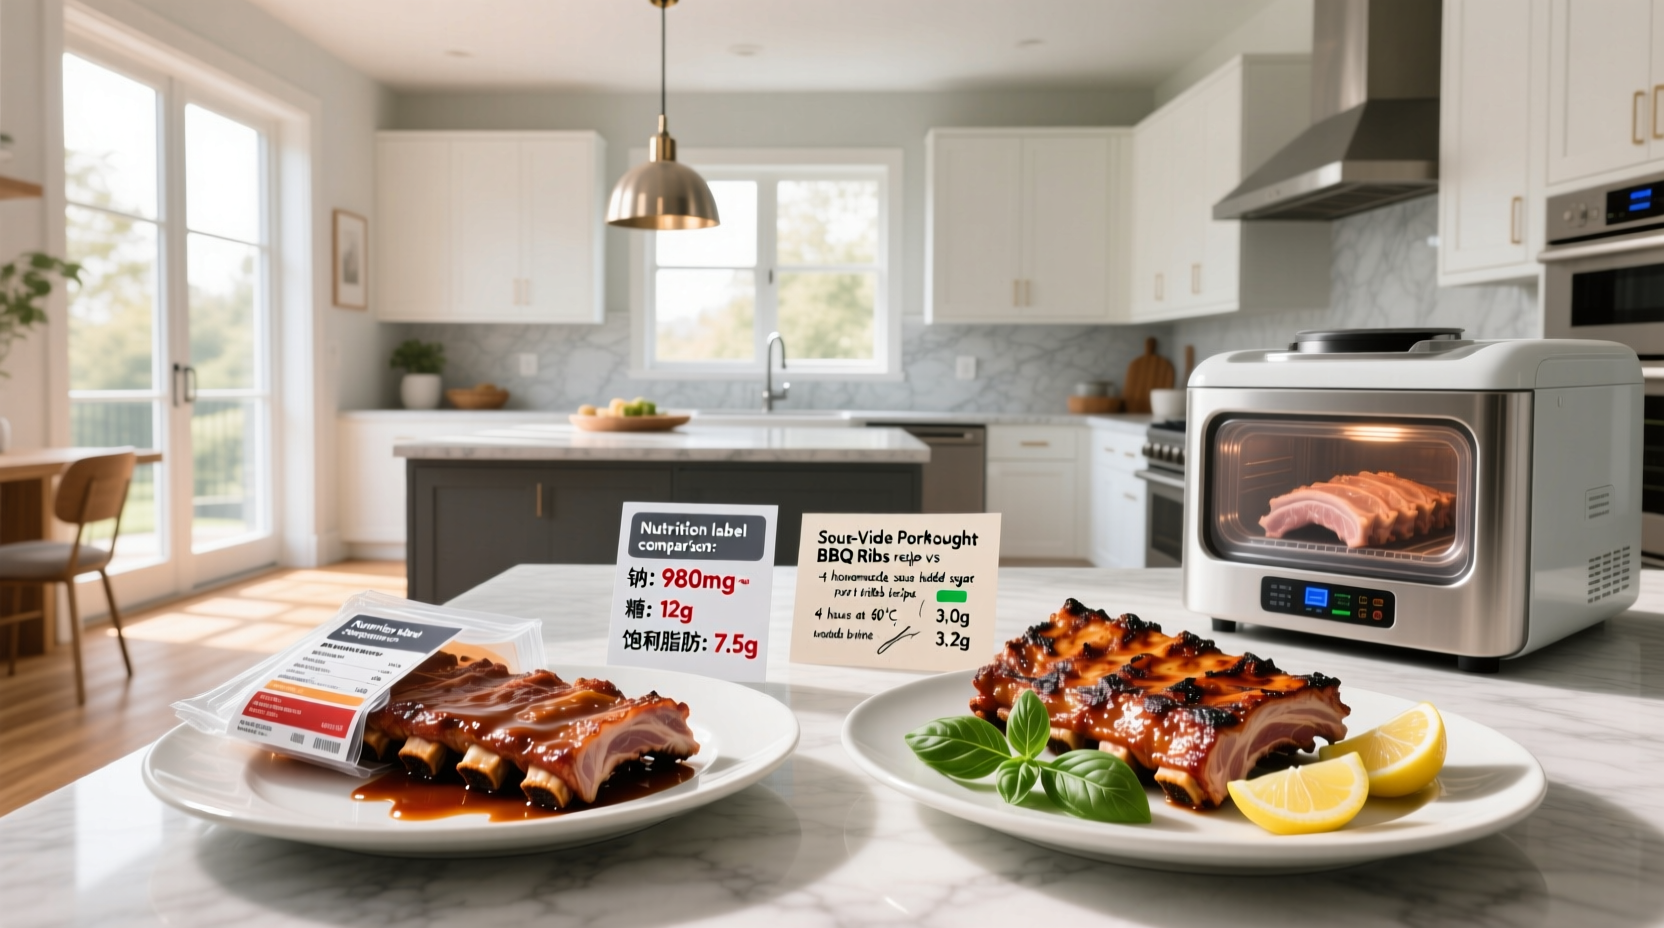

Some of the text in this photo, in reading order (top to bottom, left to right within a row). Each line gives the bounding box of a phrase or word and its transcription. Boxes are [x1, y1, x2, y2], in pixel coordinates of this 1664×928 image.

[640, 521, 748, 537] Nutrition label
[817, 547, 854, 565] BBQ
[857, 547, 890, 563] Ribs
[662, 567, 736, 596] 980mg
[660, 599, 694, 624] 12g
[814, 607, 823, 620] 4
[855, 610, 866, 620] at
[714, 632, 758, 660] 7.5g
